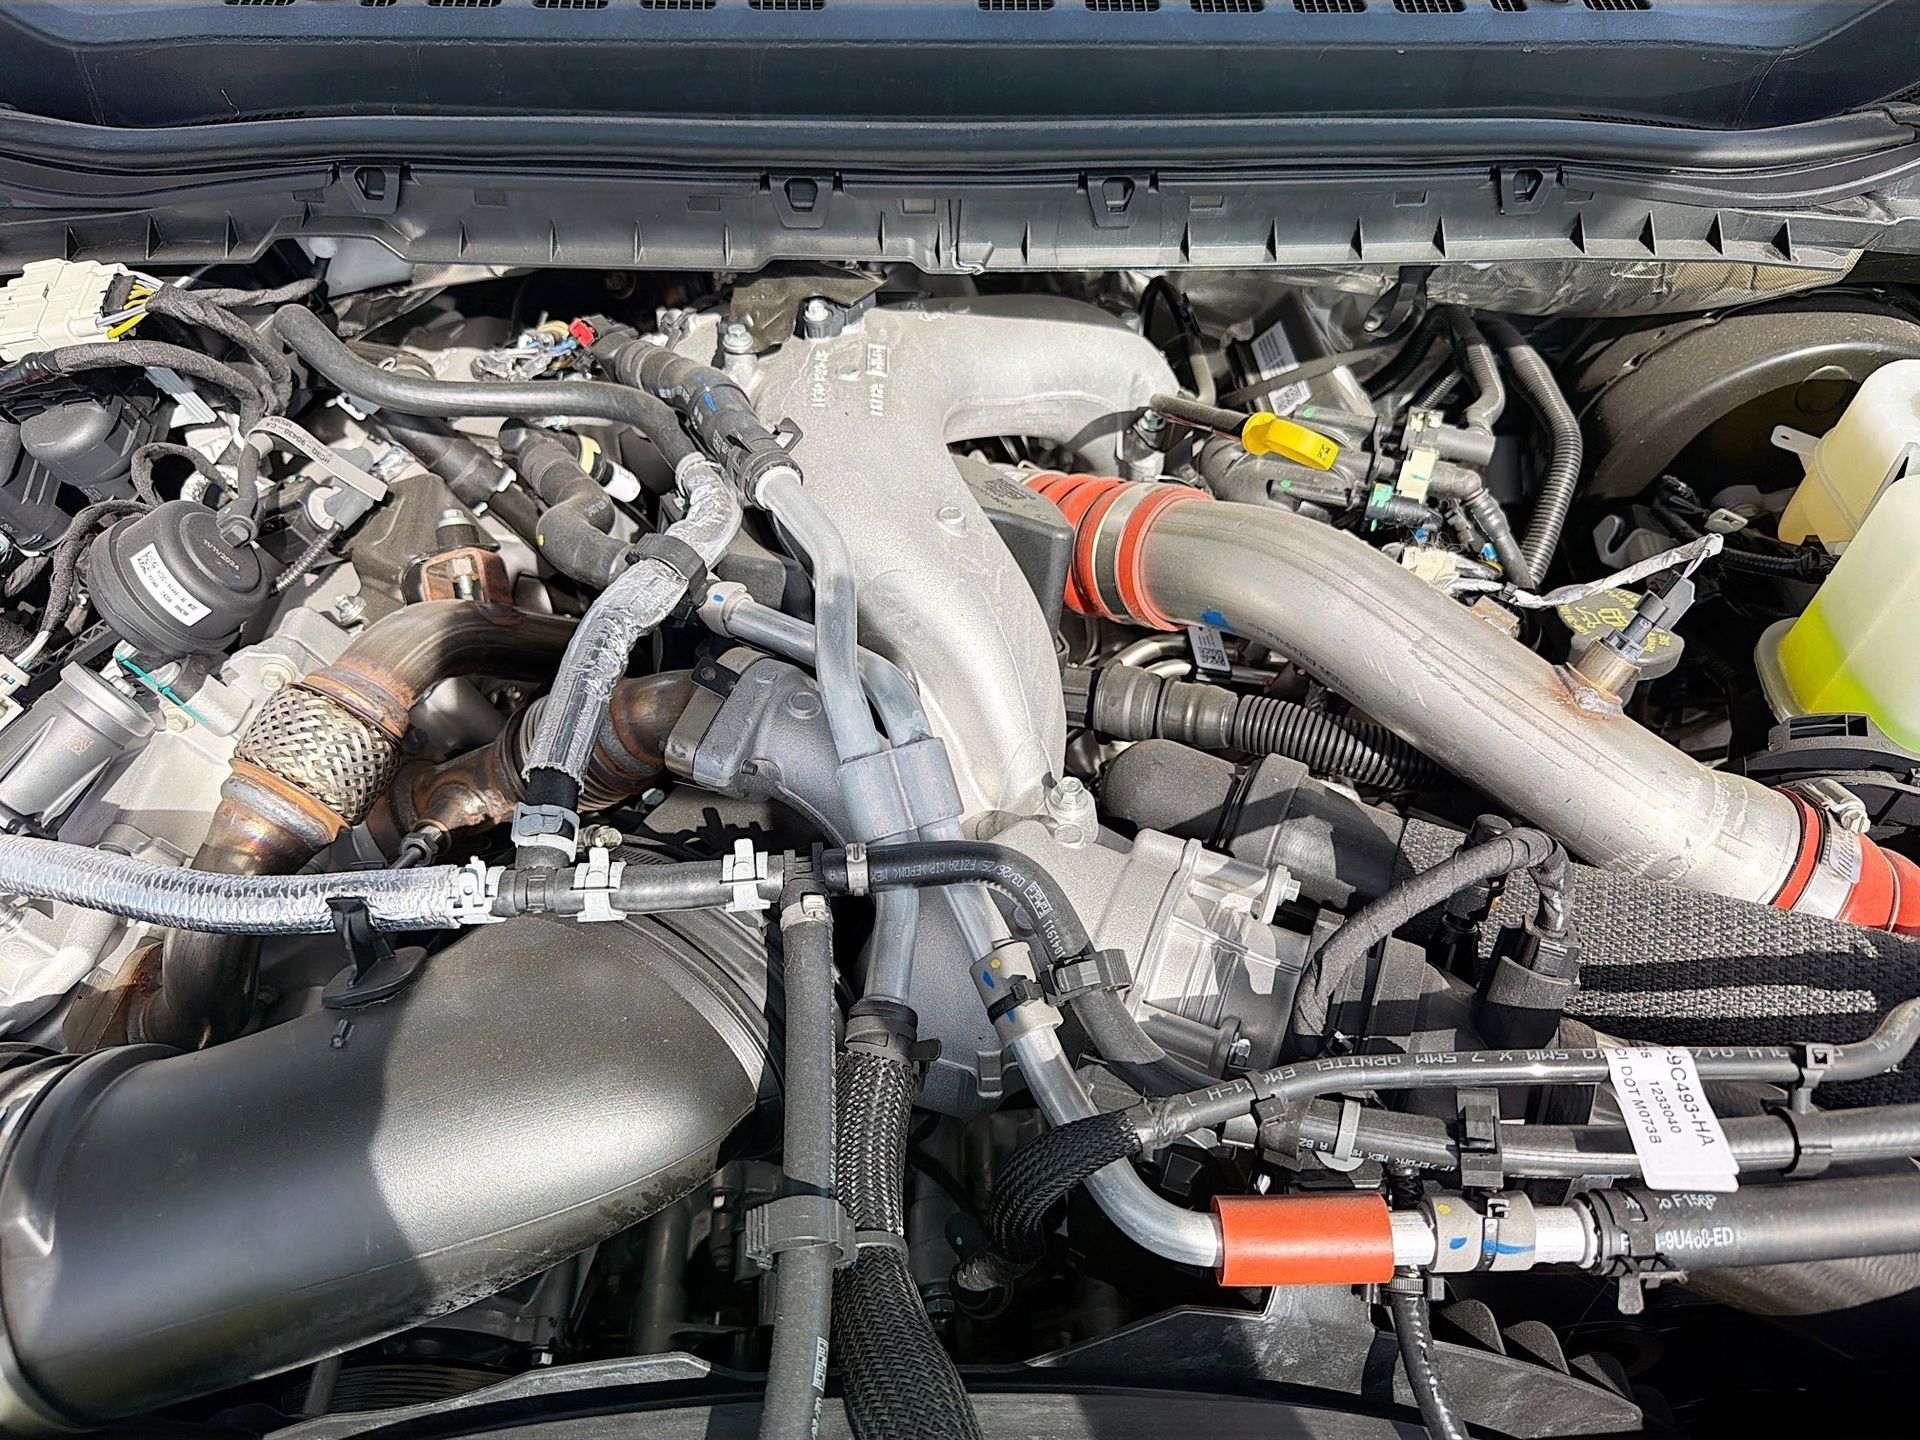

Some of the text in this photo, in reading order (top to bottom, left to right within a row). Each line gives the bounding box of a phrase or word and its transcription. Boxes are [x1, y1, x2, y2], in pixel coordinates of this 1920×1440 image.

[203, 538, 241, 571] 11/11/2024
[1620, 1065, 1641, 1096] DOT
[1632, 1099, 1662, 1145] M073B
[1648, 1080, 1682, 1134] 1233040
